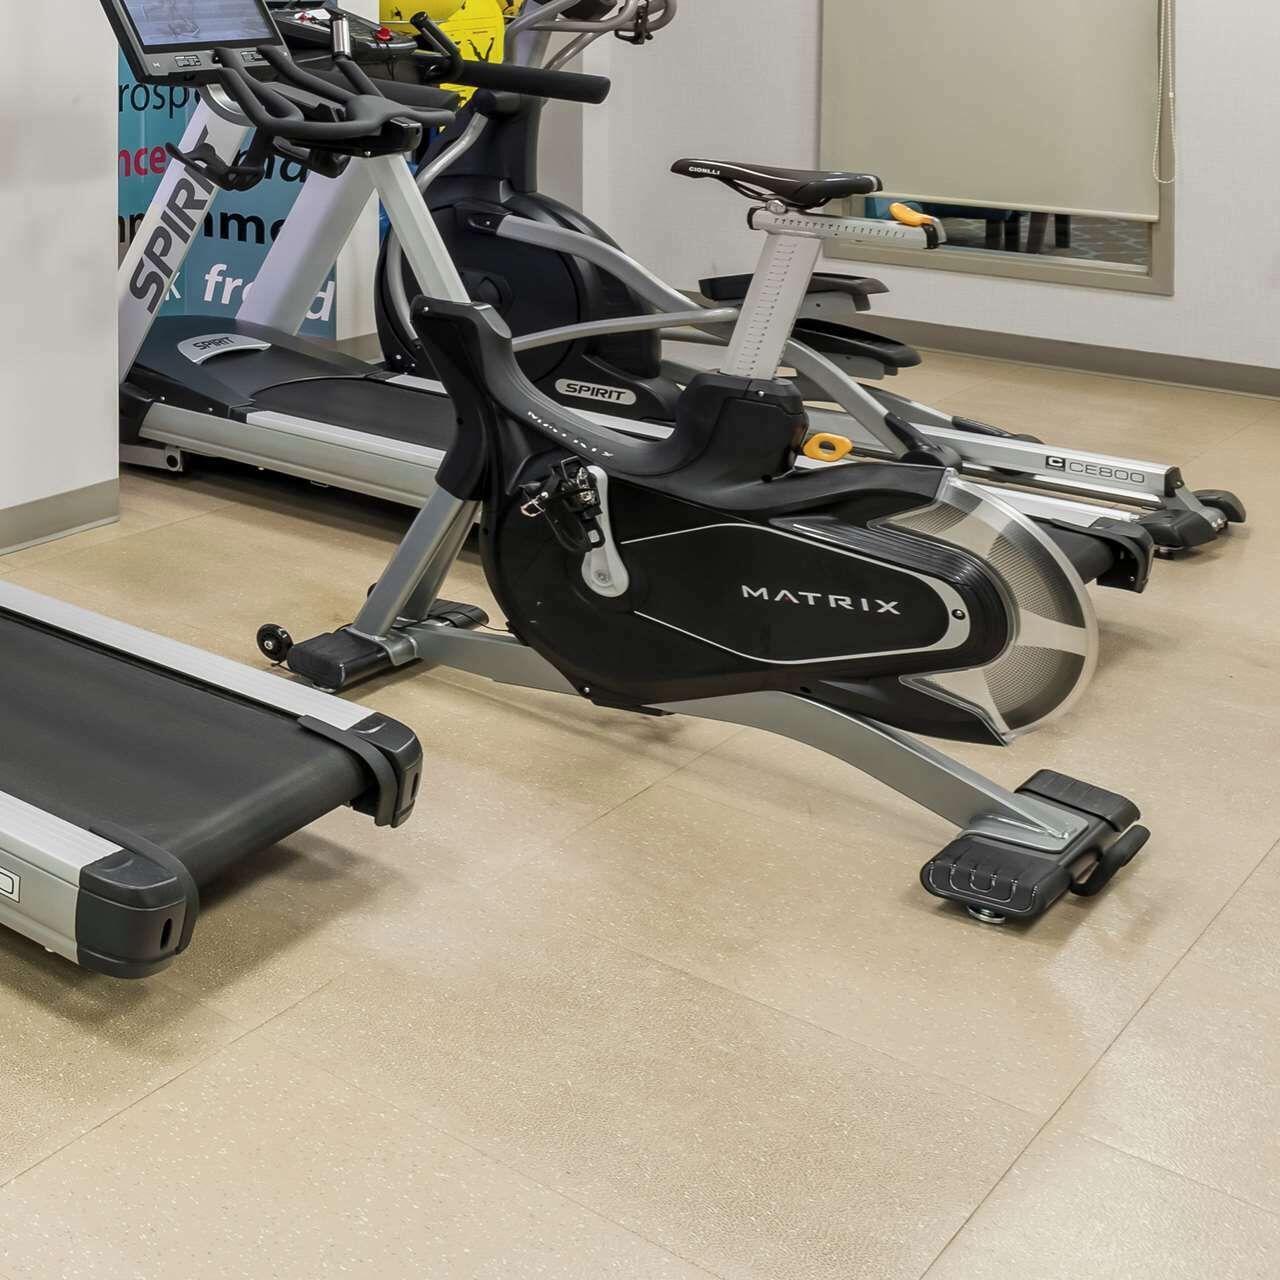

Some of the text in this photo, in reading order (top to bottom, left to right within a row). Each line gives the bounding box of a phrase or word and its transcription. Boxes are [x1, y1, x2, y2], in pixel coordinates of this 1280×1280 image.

[192, 335, 236, 351] SPIRIT
[565, 382, 627, 401] SPIRIT
[1069, 461, 1145, 484] CE800
[741, 584, 902, 616] MATRIX
